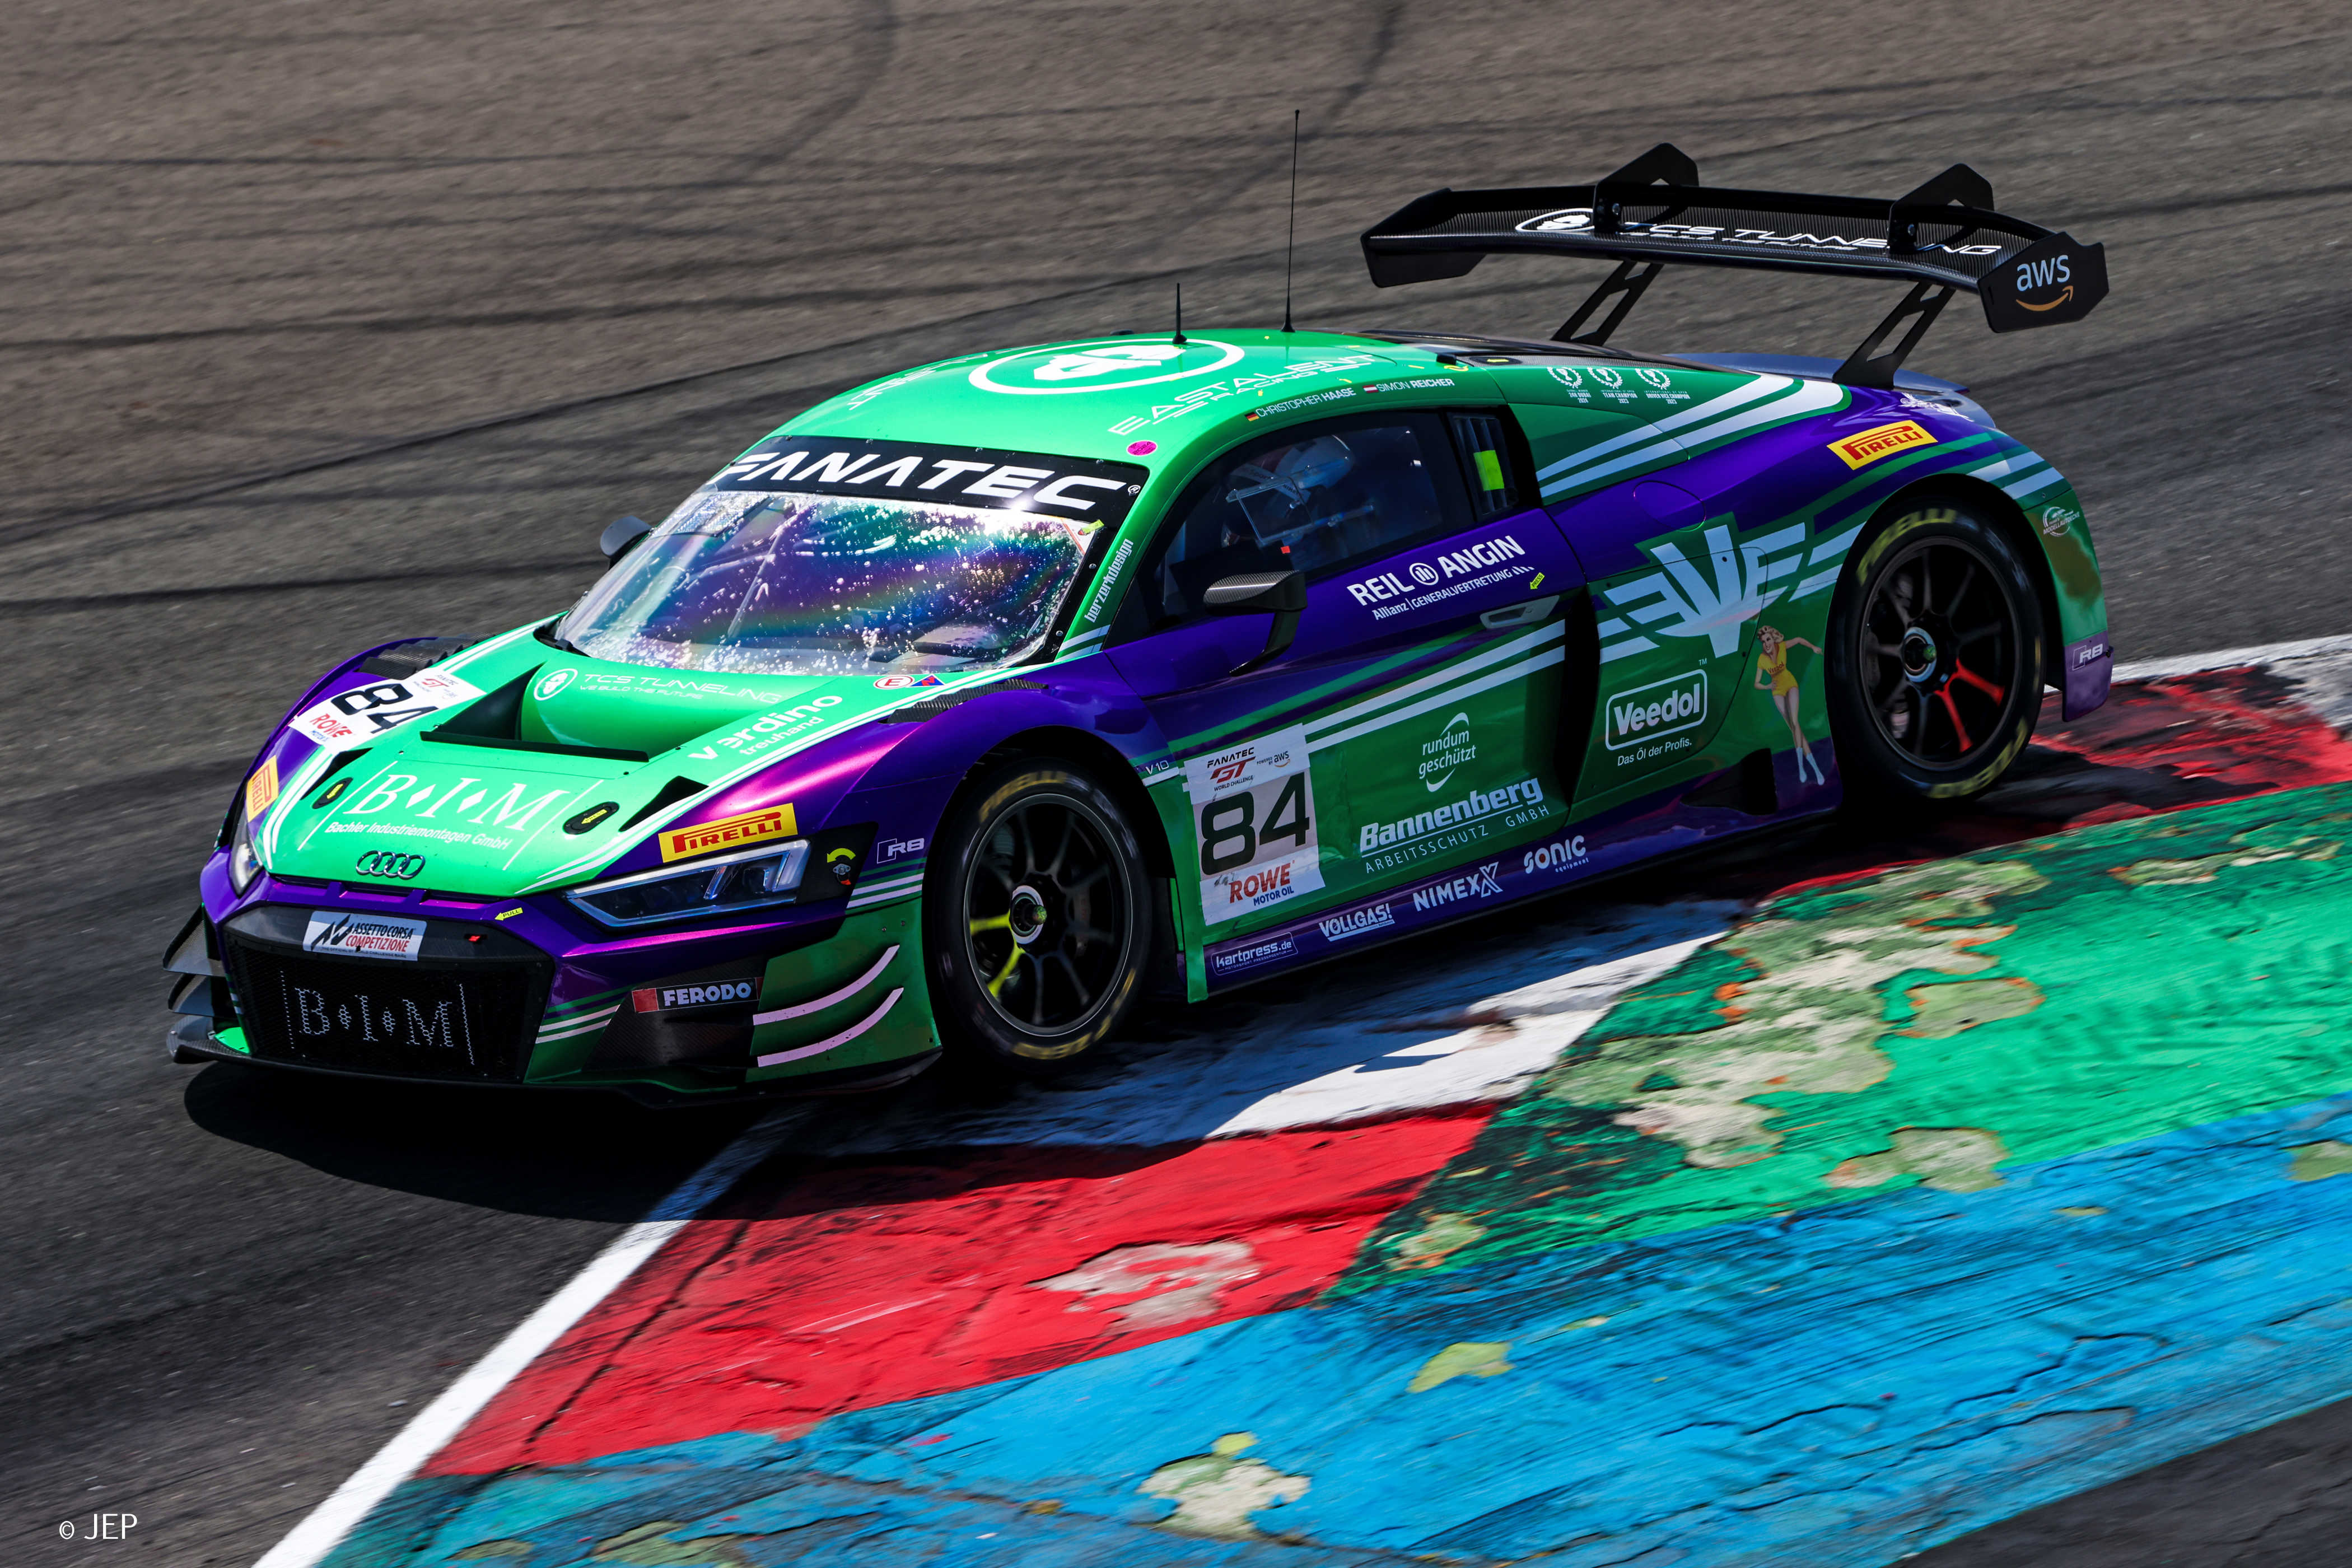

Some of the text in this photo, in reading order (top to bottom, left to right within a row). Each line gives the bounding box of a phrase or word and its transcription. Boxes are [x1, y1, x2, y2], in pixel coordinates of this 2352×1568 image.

[1734, 228, 2001, 255] TUNNEING
[2017, 255, 2070, 292] aws
[1108, 354, 1375, 436] EASTALENT
[1210, 371, 1318, 402] RACING
[1376, 378, 1455, 393] SIMON REICHER
[1256, 388, 1356, 418] CHRISTOPHER HAASE
[1841, 426, 1923, 460] PIRELLI
[706, 451, 1126, 512] FANATEC
[1084, 538, 1134, 623] berzerkdesign
[1346, 535, 1525, 606] REIL ANGIN
[1372, 568, 1513, 620] Allianz GENERALVERTRETUNG
[2079, 644, 2103, 664] R8
[585, 673, 783, 704] TCS TUNNELING
[655, 689, 704, 700] FUTURE
[331, 683, 439, 734] 84
[1613, 683, 1700, 736] Veedol
[309, 713, 353, 738] ROWE
[739, 716, 825, 755] treuhand
[1207, 746, 1255, 769] FANATEC
[1274, 750, 1290, 763] aws
[1422, 730, 1470, 756] rundum
[1618, 736, 1692, 767] Das Öl der Profis.
[1145, 760, 1169, 775] V10
[1210, 756, 1257, 784] GT
[1418, 745, 1477, 780] geschützt
[252, 764, 272, 812] PIRELLI
[1214, 774, 1254, 792] WORLD CHALLENGE
[1201, 772, 1310, 876] 84
[1360, 777, 1544, 853] Bannenberg
[325, 822, 512, 851] Bachler Industriemontagen GmbH
[673, 811, 782, 853] PIRELLI
[887, 838, 925, 857] R8
[1365, 805, 1550, 874] ARBEITSSCHUTZ GMBH
[1229, 862, 1291, 904] ROWE
[1253, 885, 1294, 907] MOTOR OIL
[503, 909, 520, 918] PULL
[1318, 903, 1393, 937] VOLLGAS!
[346, 935, 410, 953] COMPETIZIONE
[353, 922, 414, 940] ASSETTO CORSA
[1216, 941, 1292, 968] kartpress.de
[663, 982, 752, 1007] FERODO
